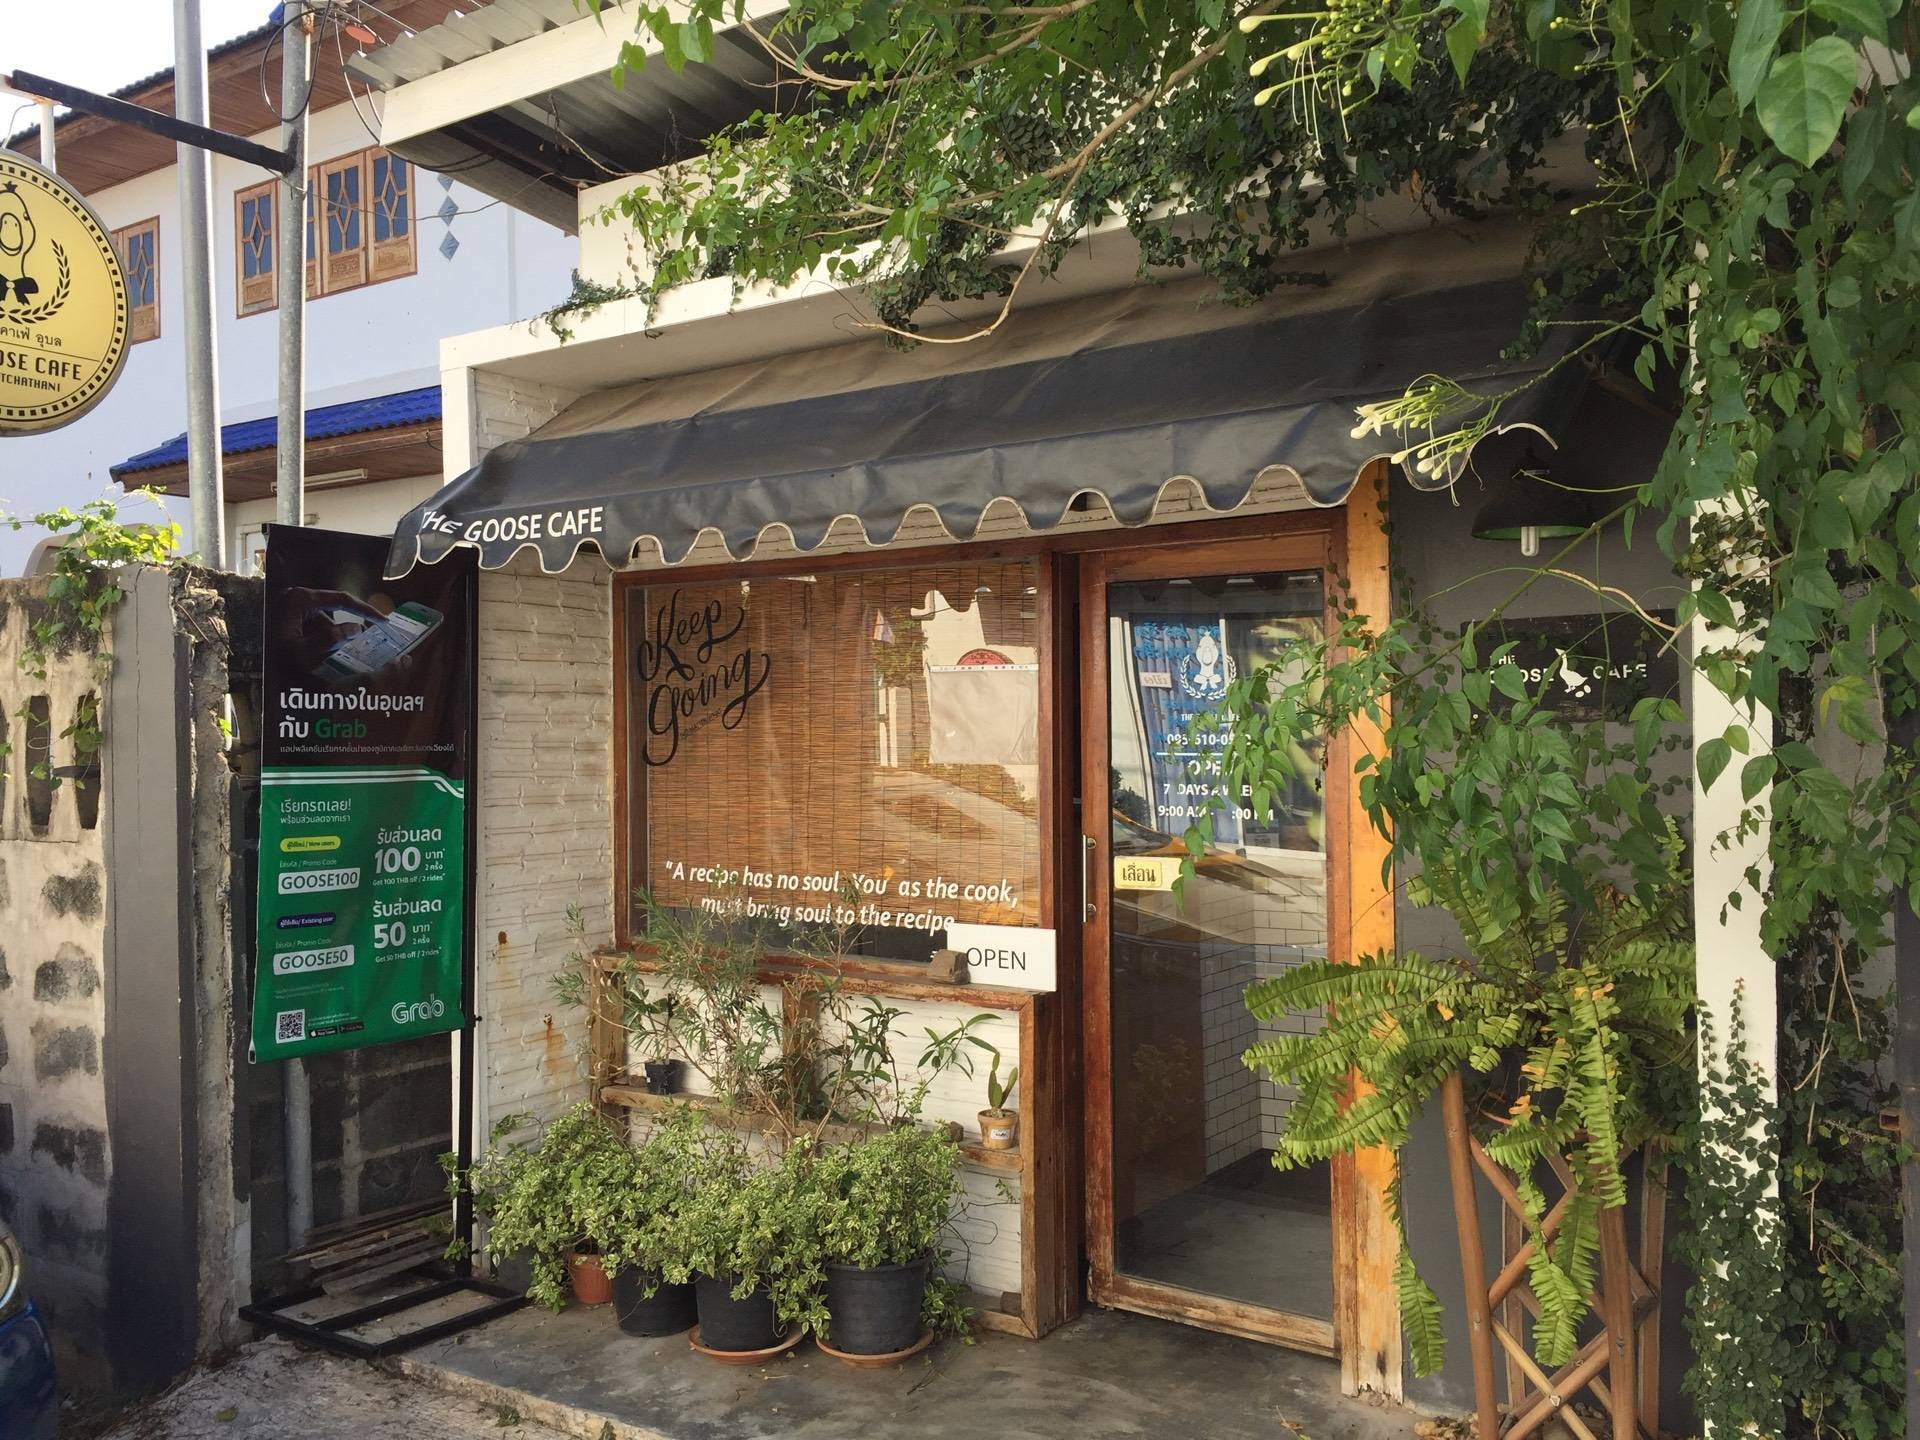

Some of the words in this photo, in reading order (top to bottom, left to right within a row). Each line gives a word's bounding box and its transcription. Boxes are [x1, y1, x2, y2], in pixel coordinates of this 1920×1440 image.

[36, 333, 62, 348] อุบล
[35, 357, 82, 380] CAFE
[464, 514, 543, 542] GOOSE
[548, 507, 604, 537] CAFE
[637, 588, 744, 681] Keep
[280, 687, 424, 717] เดินทางในอุบลฯ
[279, 715, 309, 738] กับ
[315, 718, 367, 738] Grab
[1163, 784, 1171, 795] 7
[1177, 784, 1209, 796] DAYS
[280, 798, 352, 812] เรียกรถเลย!
[1158, 805, 1184, 817] 9:00
[377, 825, 442, 844] รับส่วนลด
[374, 846, 421, 874] 100
[281, 871, 358, 889] GOOSE100
[1122, 862, 1156, 882] เลื่อน
[665, 860, 685, 881] "A
[742, 865, 773, 888] has
[777, 874, 799, 890] no
[852, 872, 888, 894] You
[898, 879, 922, 898] as
[926, 876, 958, 899] the
[964, 879, 1018, 909] cook,
[373, 897, 442, 918] รับส่วนลด
[795, 902, 831, 924] soul
[836, 905, 855, 925] to
[860, 903, 891, 927] the
[895, 909, 955, 936] recipe
[374, 921, 406, 949] 50
[280, 949, 348, 970] GOOSE50
[966, 947, 1026, 971] OPEN
[391, 993, 445, 1024] Grab
